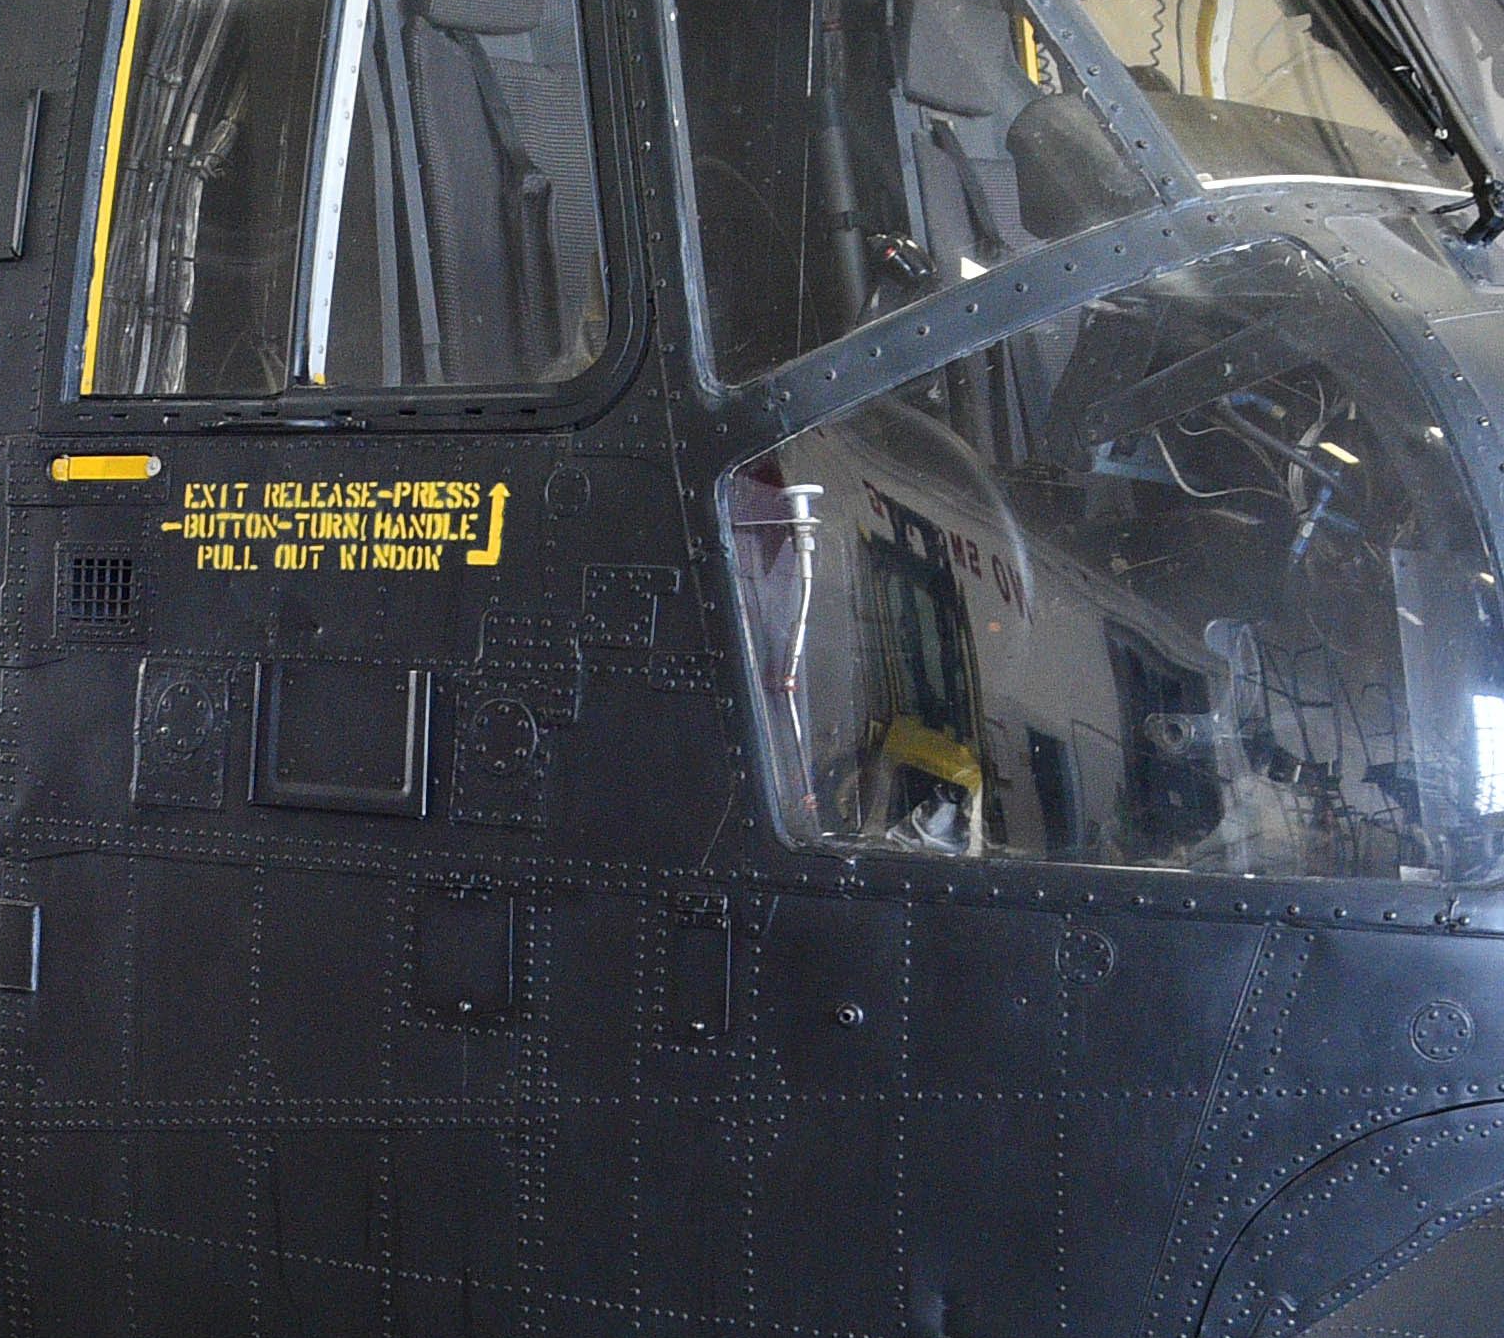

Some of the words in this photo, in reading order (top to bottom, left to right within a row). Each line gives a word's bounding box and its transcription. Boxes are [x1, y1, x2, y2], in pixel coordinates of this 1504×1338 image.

[183, 482, 249, 510] EXIT
[263, 481, 481, 510] RELEASE-PRESS
[197, 544, 258, 571] PULL
[274, 544, 325, 571] OUT
[340, 544, 443, 572] WINDOW
